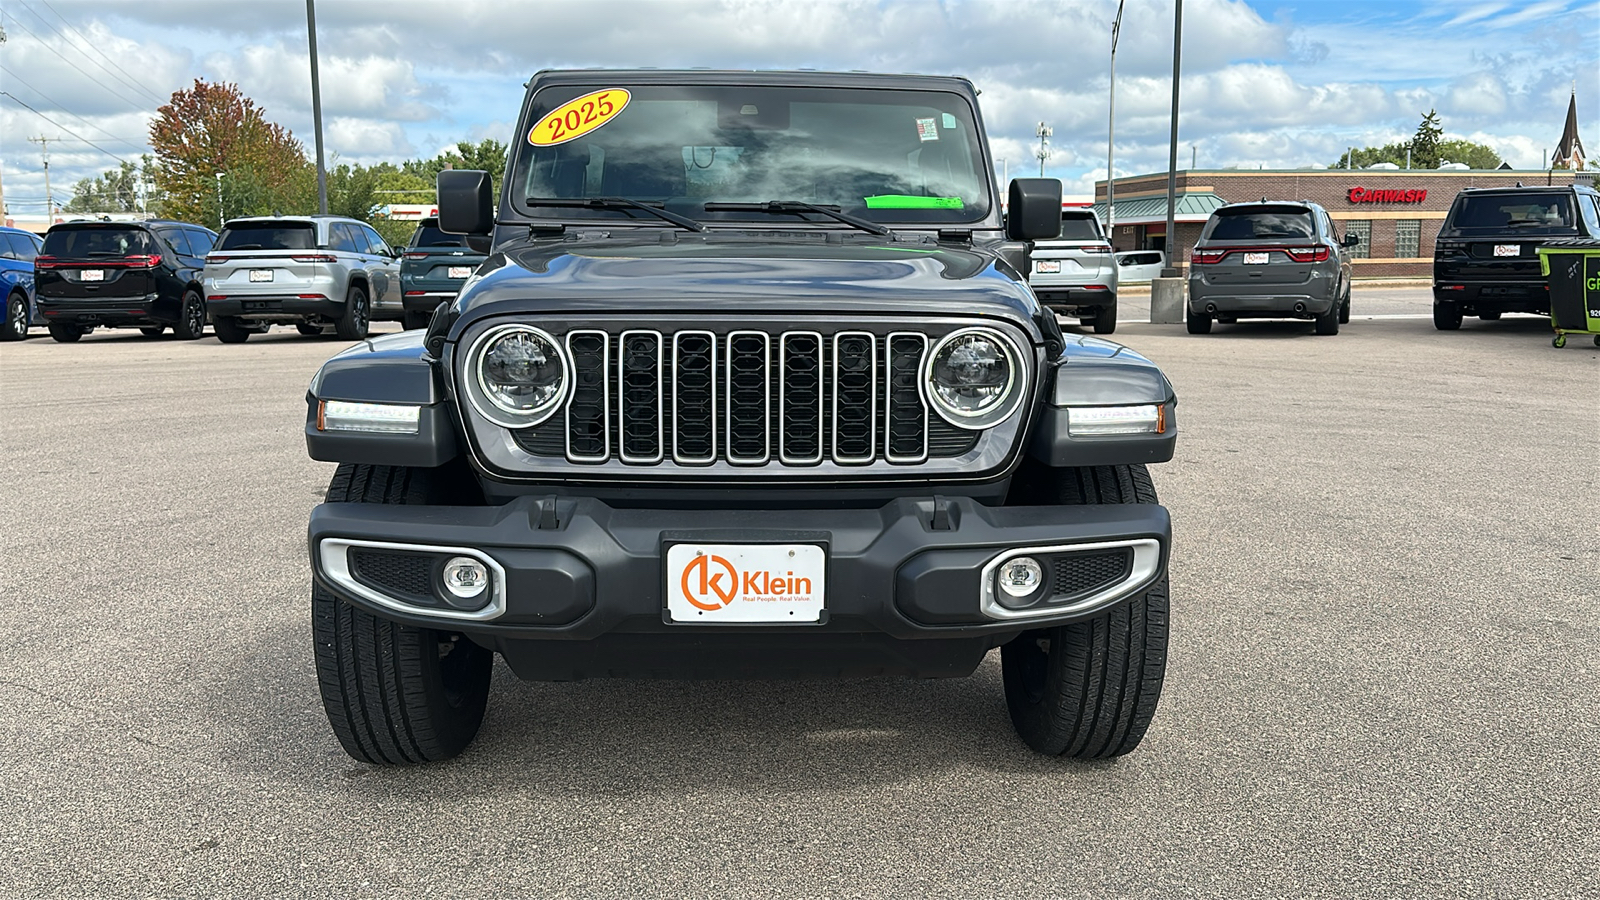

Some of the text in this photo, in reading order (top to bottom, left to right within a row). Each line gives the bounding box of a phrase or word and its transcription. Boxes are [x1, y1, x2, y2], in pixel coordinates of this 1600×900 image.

[548, 93, 614, 141] 2025
[1349, 186, 1428, 203] CARWASH
[1122, 226, 1135, 235] EXIT
[743, 571, 812, 594] Klein
